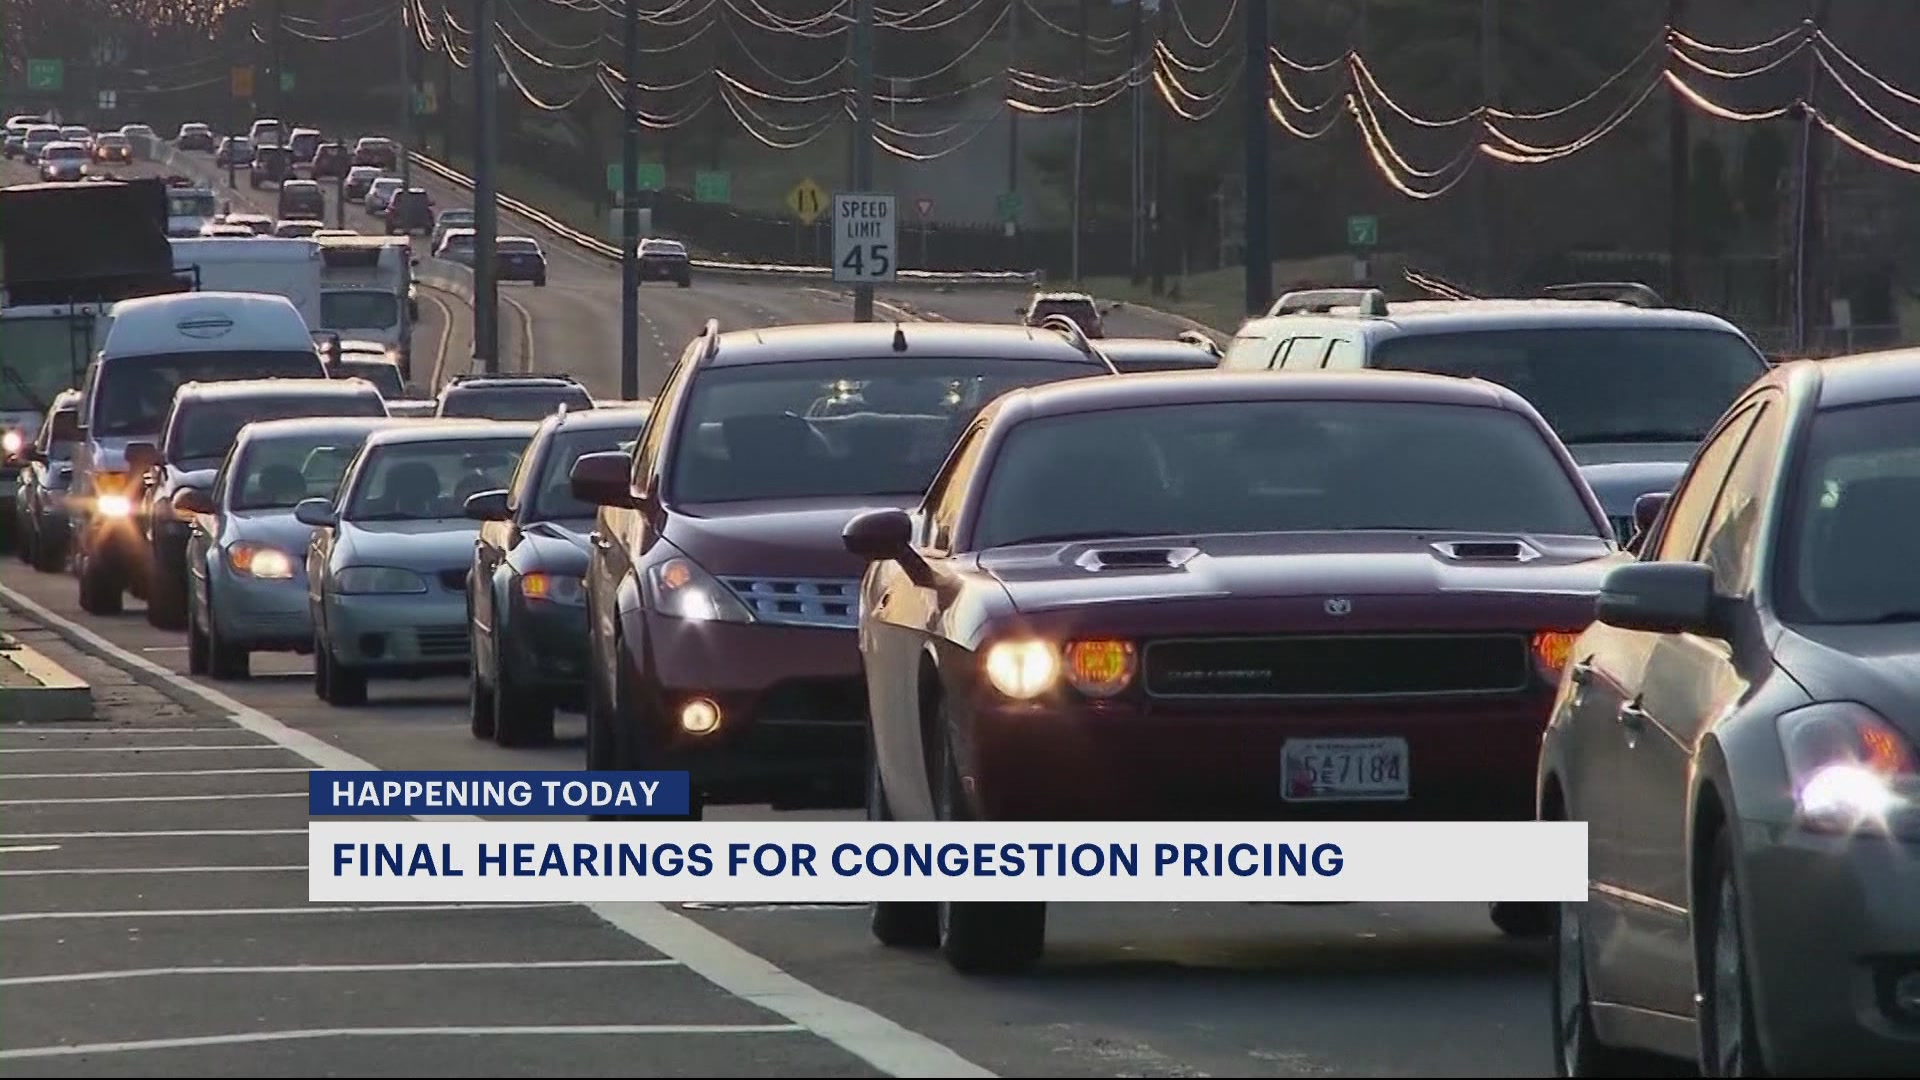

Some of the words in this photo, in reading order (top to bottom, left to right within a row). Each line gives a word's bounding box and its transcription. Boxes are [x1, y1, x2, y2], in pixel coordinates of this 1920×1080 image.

[842, 201, 887, 218] SPEED
[847, 221, 881, 238] LIMIT
[842, 244, 889, 276] 45
